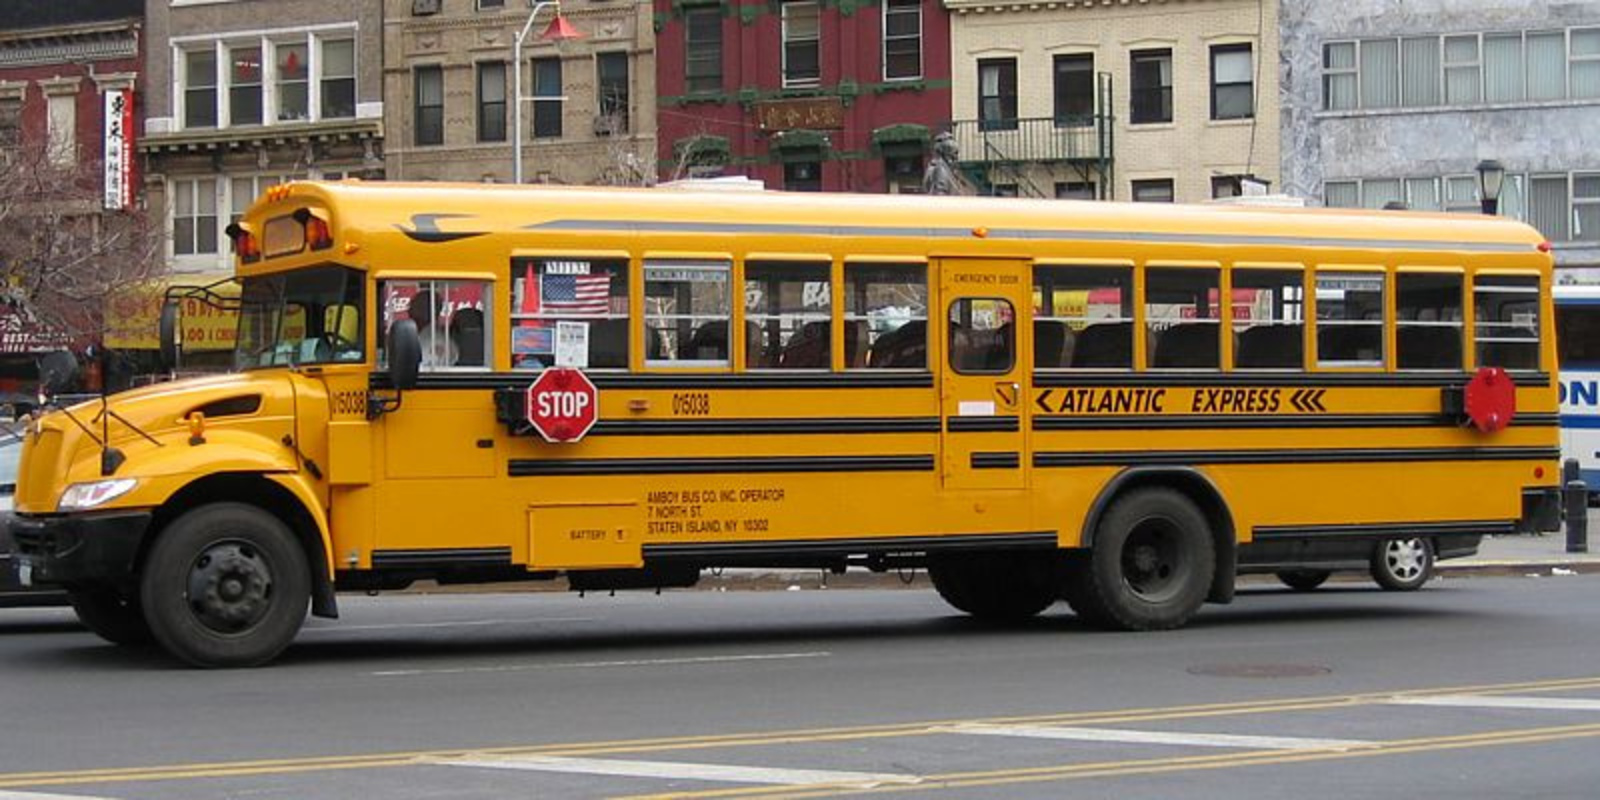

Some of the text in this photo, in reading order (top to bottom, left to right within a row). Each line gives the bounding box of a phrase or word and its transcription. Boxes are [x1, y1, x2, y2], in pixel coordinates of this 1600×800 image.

[954, 274, 997, 283] EMERGENCY
[538, 391, 589, 417] STOP
[672, 393, 710, 415] 015038
[1059, 389, 1281, 412] ATLANTIC EXPRESS
[647, 491, 679, 503] AMBOY
[682, 490, 700, 503] BUS
[740, 489, 785, 502] OPERATOR
[648, 505, 653, 518] 7
[656, 505, 688, 518] NORTH
[647, 521, 682, 534] STATEN
[725, 520, 738, 532] NY
[744, 519, 768, 531] 10302
[570, 529, 606, 541] BATTERY
